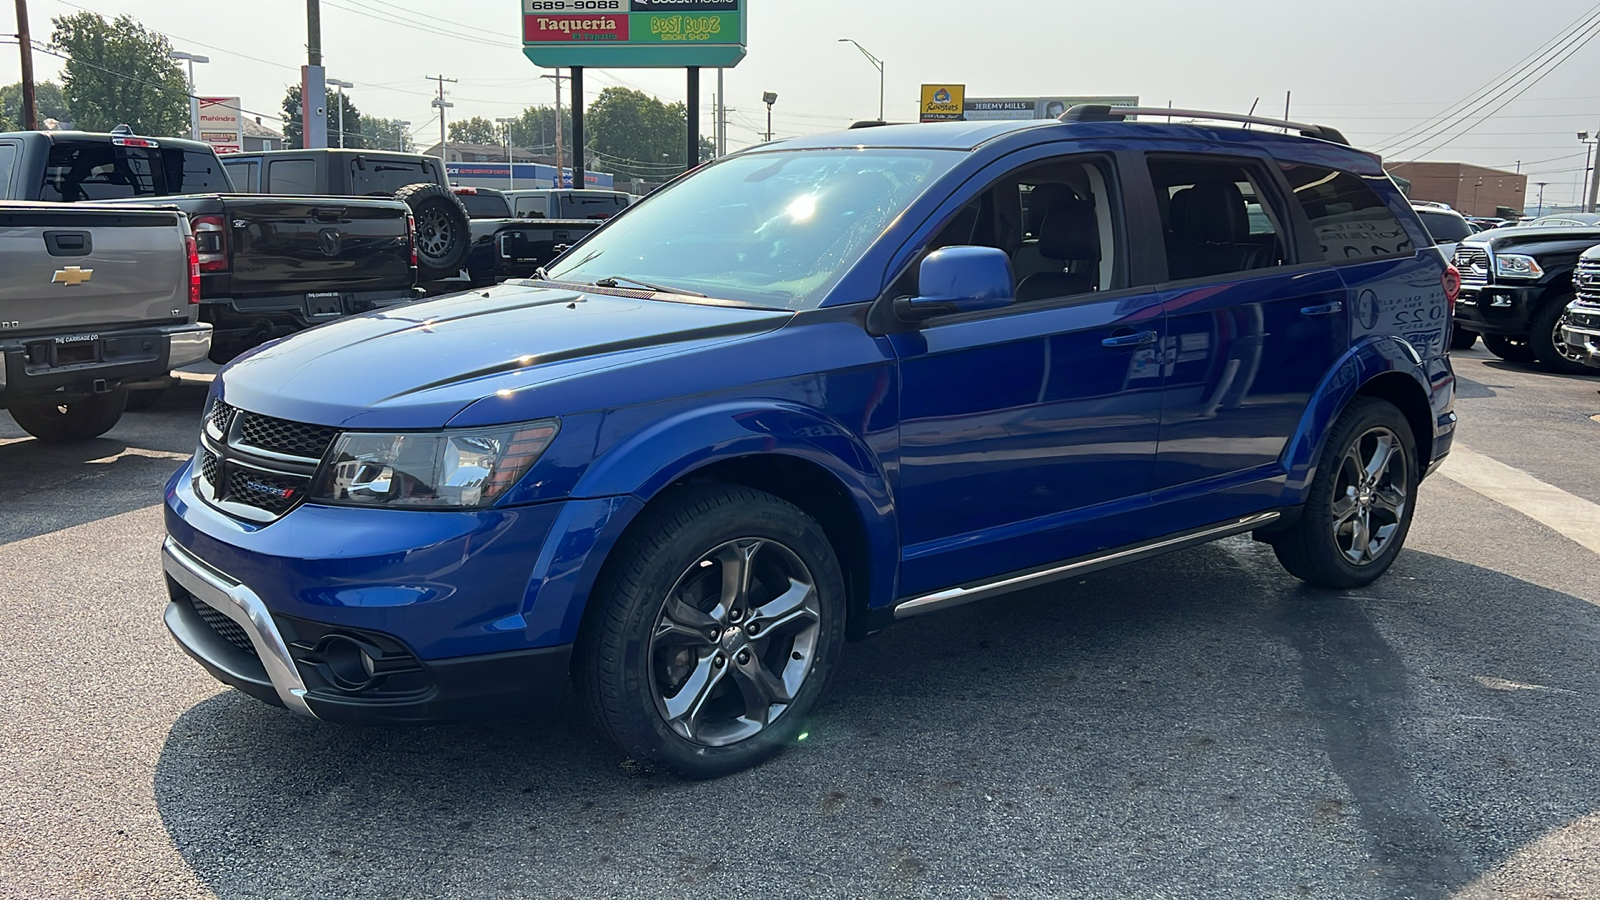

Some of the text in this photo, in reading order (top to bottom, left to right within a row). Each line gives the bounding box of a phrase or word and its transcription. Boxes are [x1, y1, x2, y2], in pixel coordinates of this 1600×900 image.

[537, 16, 617, 33] Taquería
[661, 33, 710, 41] SMOKE SHOP
[1004, 102, 1026, 110] MILLS
[65, 335, 90, 343] CARRIAGE
